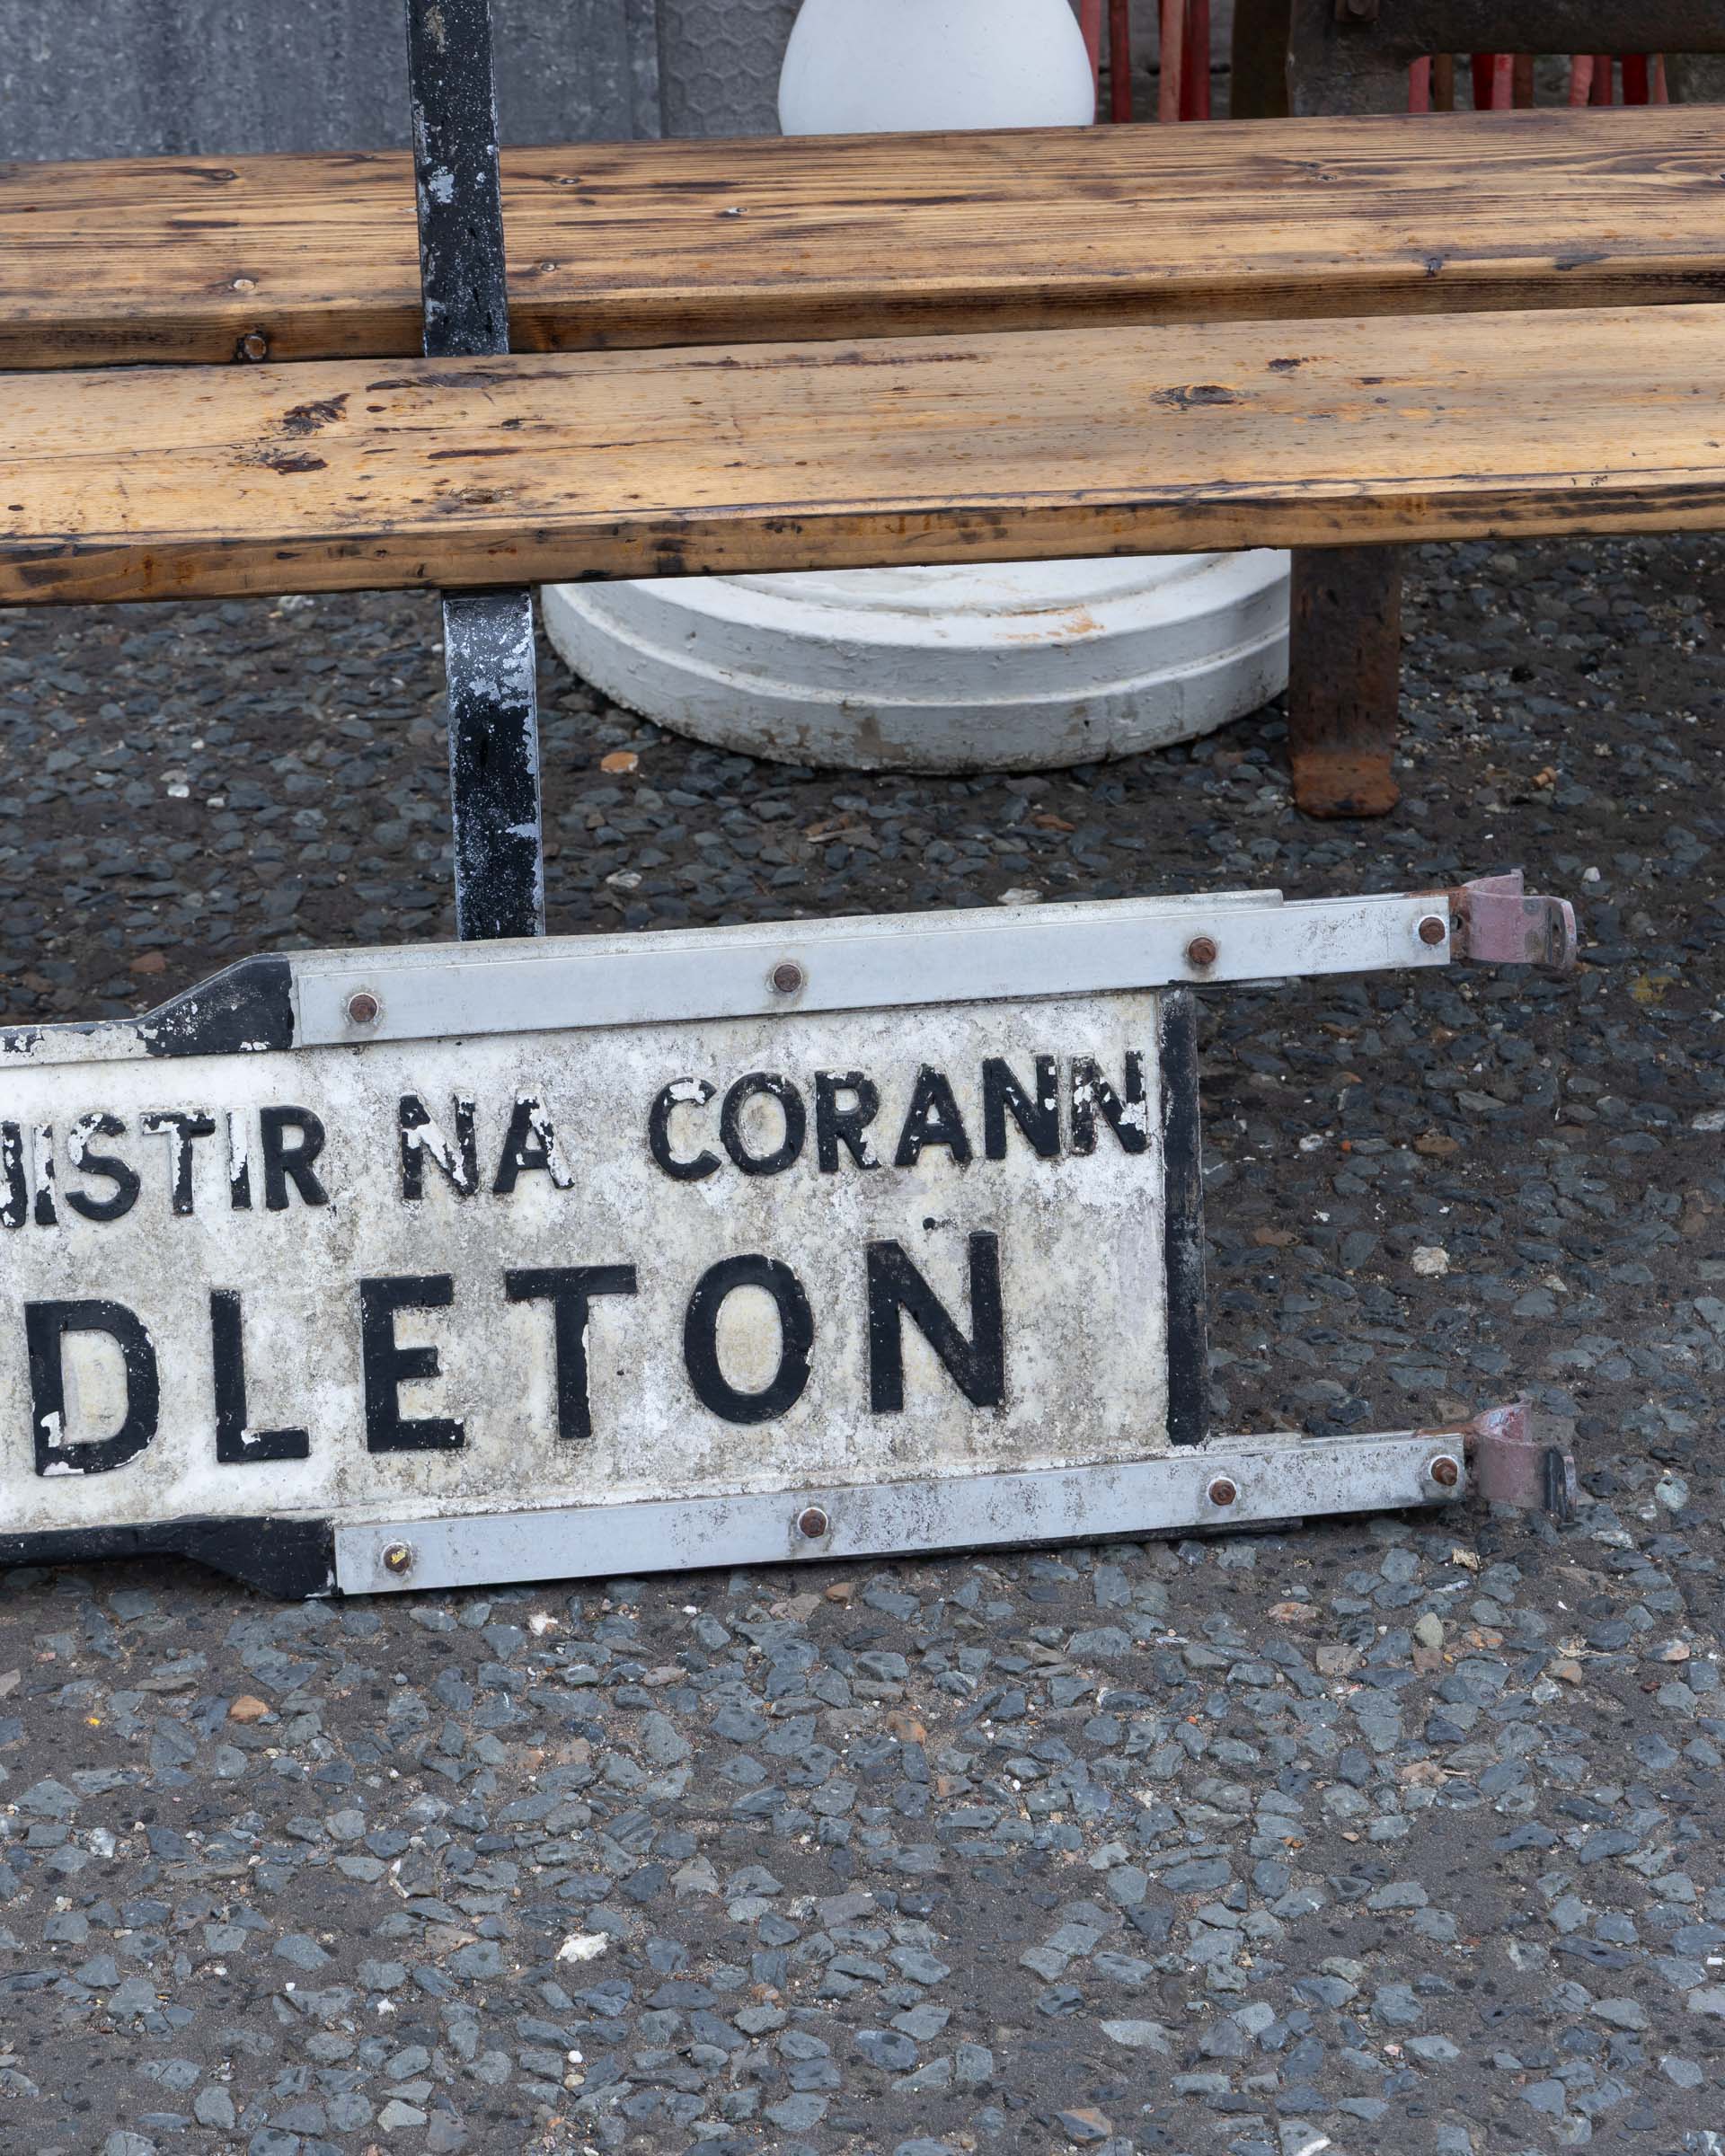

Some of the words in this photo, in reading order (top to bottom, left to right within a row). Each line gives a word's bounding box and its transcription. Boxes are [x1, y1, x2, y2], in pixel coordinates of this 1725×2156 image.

[398, 1085, 576, 1201] NA
[647, 1048, 1152, 1180] CORANN
[24, 1229, 1006, 1476] DLETON
